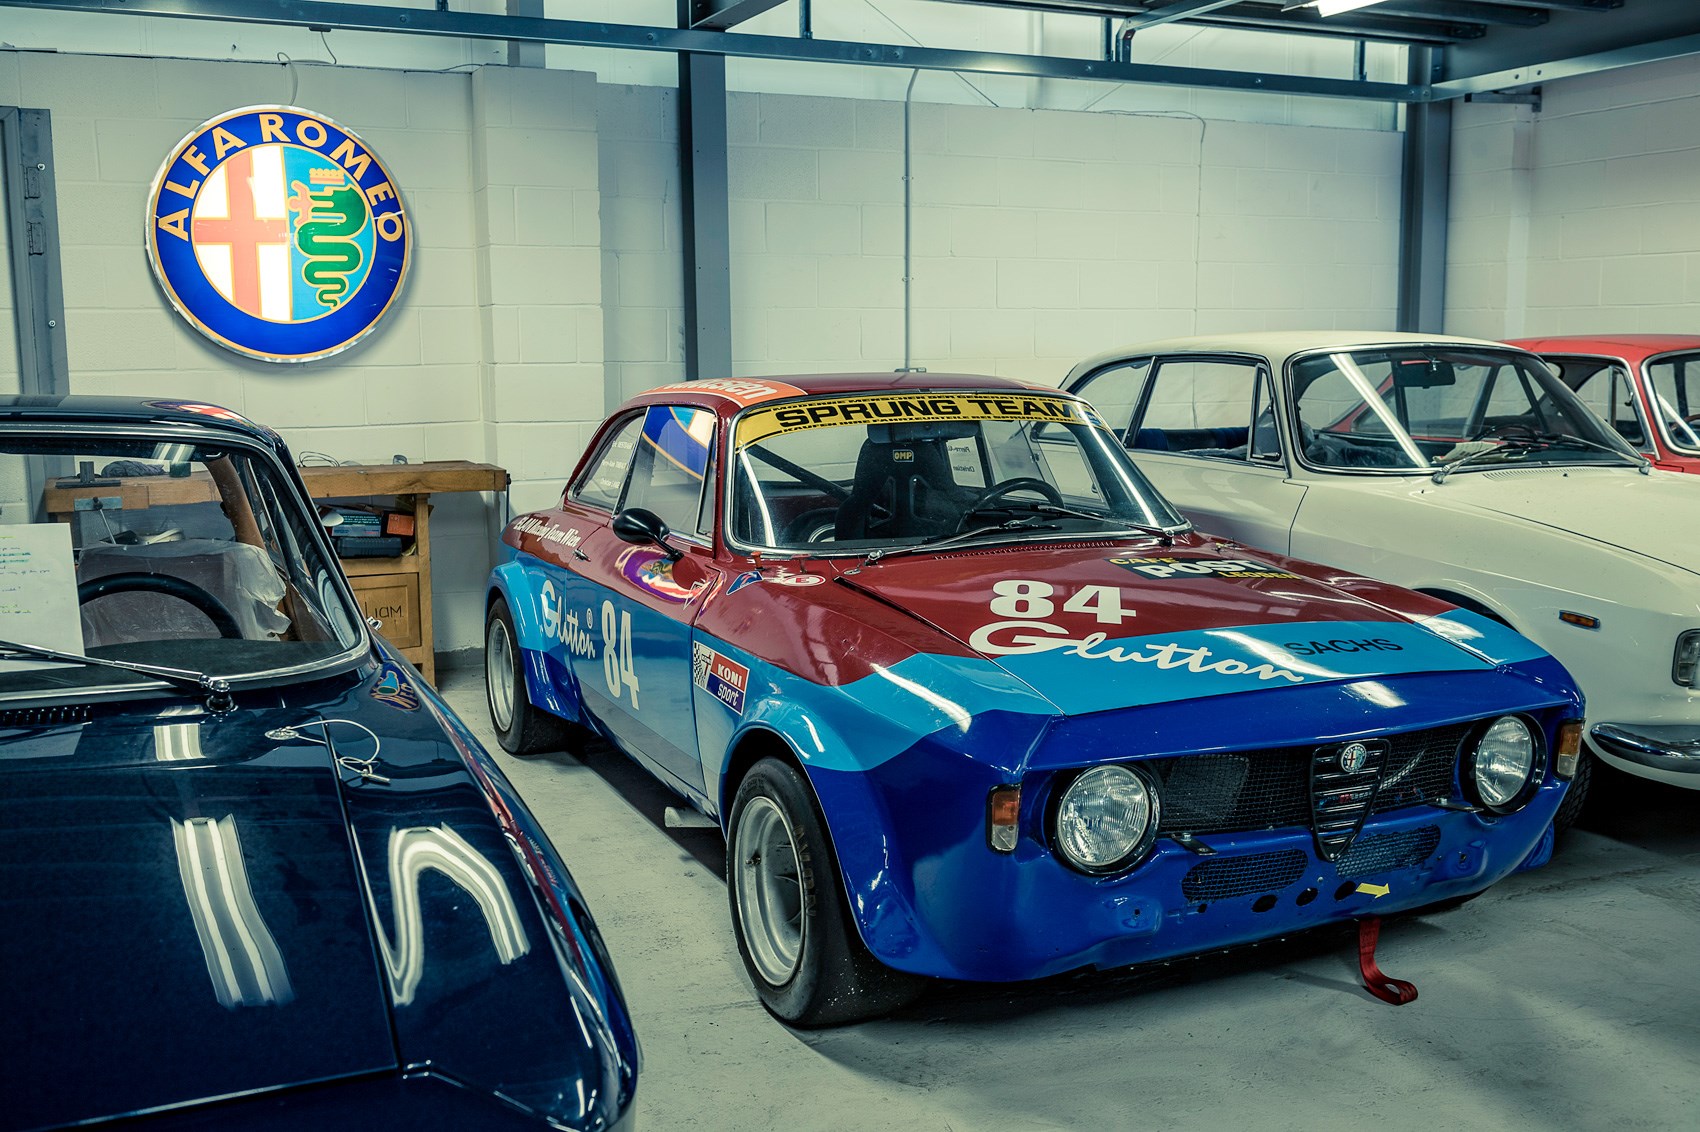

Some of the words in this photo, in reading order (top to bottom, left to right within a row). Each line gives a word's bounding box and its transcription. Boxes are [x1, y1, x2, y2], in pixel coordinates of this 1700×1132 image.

[158, 126, 248, 242] ALFA
[258, 113, 403, 242] ROMEO
[775, 399, 962, 428] SPRUNG
[966, 399, 1072, 418] TEAM
[894, 451, 913, 460] OMP
[1132, 559, 1268, 578] POST
[989, 579, 1137, 625] 84
[541, 579, 596, 660] Glutton
[601, 599, 640, 711] 84
[968, 620, 1305, 683] Glutton
[1283, 638, 1404, 656] SACHS
[717, 663, 743, 688] KONI
[717, 683, 740, 707] sport
